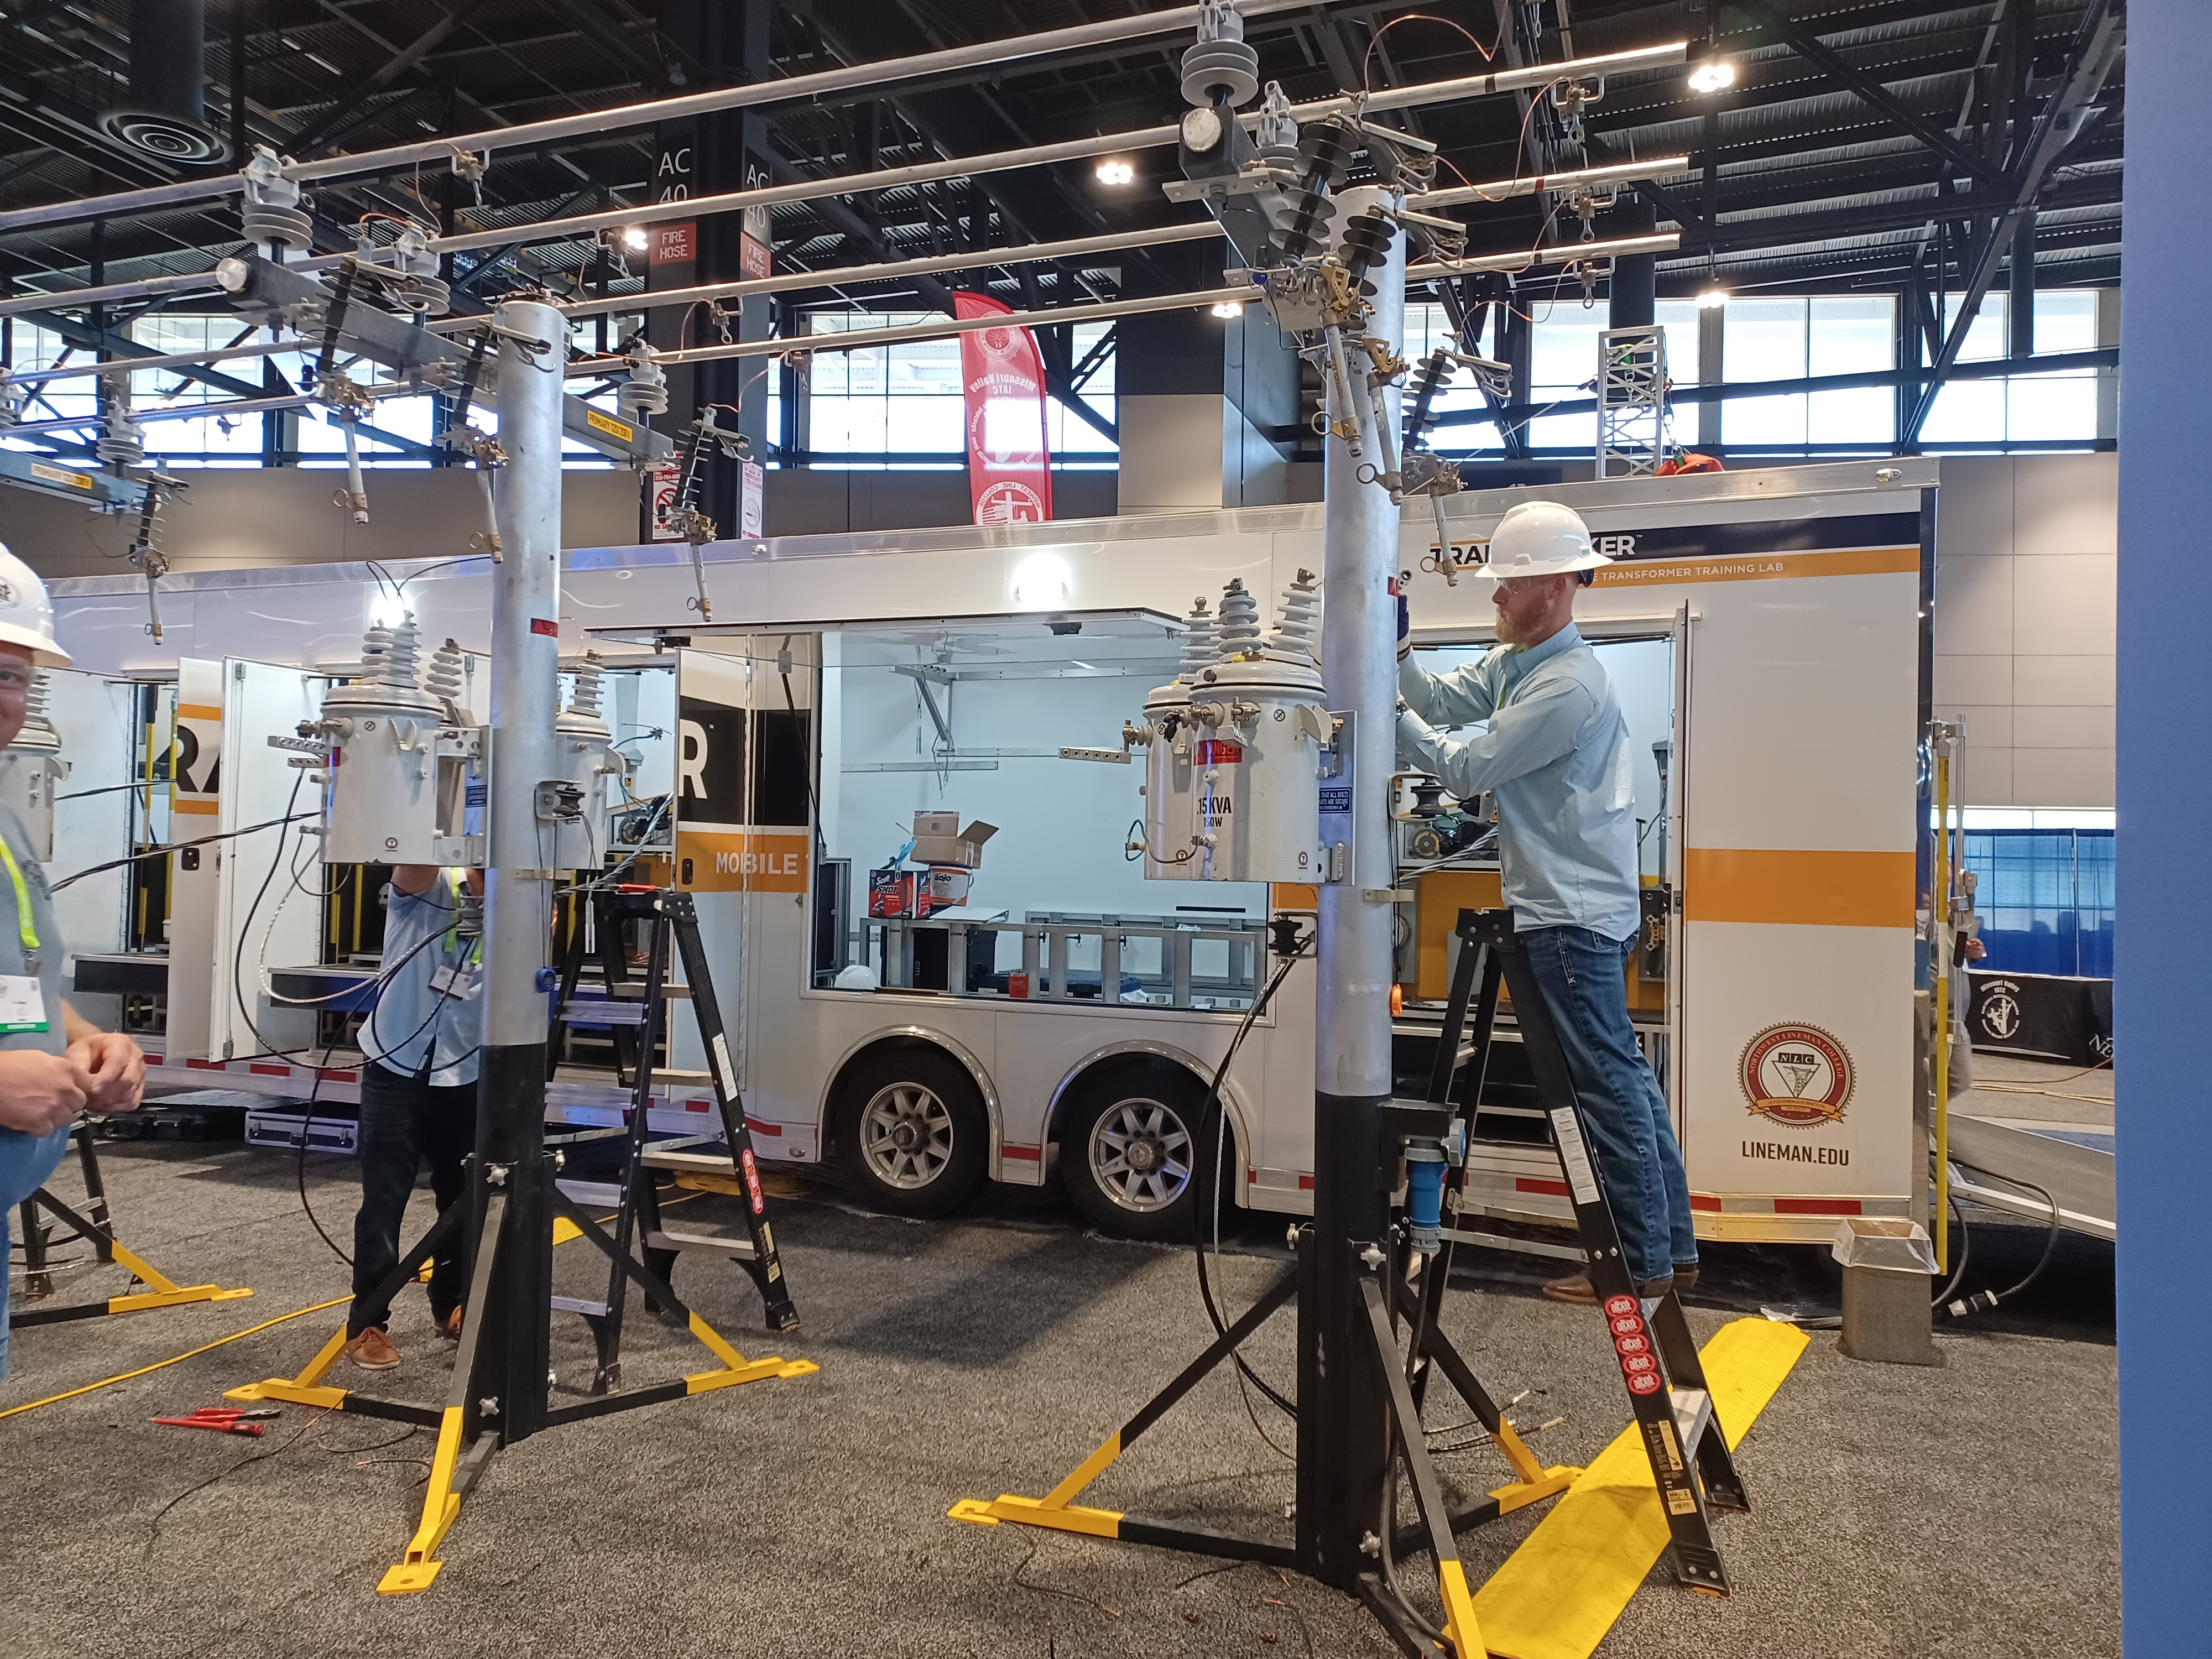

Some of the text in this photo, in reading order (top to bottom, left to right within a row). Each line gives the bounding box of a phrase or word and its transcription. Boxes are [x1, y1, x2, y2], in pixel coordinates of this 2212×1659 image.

[658, 148, 691, 177] AC
[747, 164, 769, 190] AC
[659, 184, 688, 204] 40
[747, 205, 766, 228] 40
[661, 229, 686, 244] FIRE
[660, 244, 687, 259] HOSE
[748, 243, 764, 264] FIRE
[747, 256, 765, 279] HOSE
[588, 413, 610, 431] PRIMARY
[1601, 568, 1691, 581] TRANSFORMER
[1696, 564, 1755, 576] TRAINING
[1759, 562, 1784, 572] LAB
[1209, 797, 1232, 814] KVA
[716, 852, 798, 875] MOBILE
[1749, 1031, 1845, 1079] NORTHWEST LINEMAN COLLEGE
[2089, 1033, 2114, 1057] NE
[1742, 1141, 1849, 1166] LINEMAN.EDU
